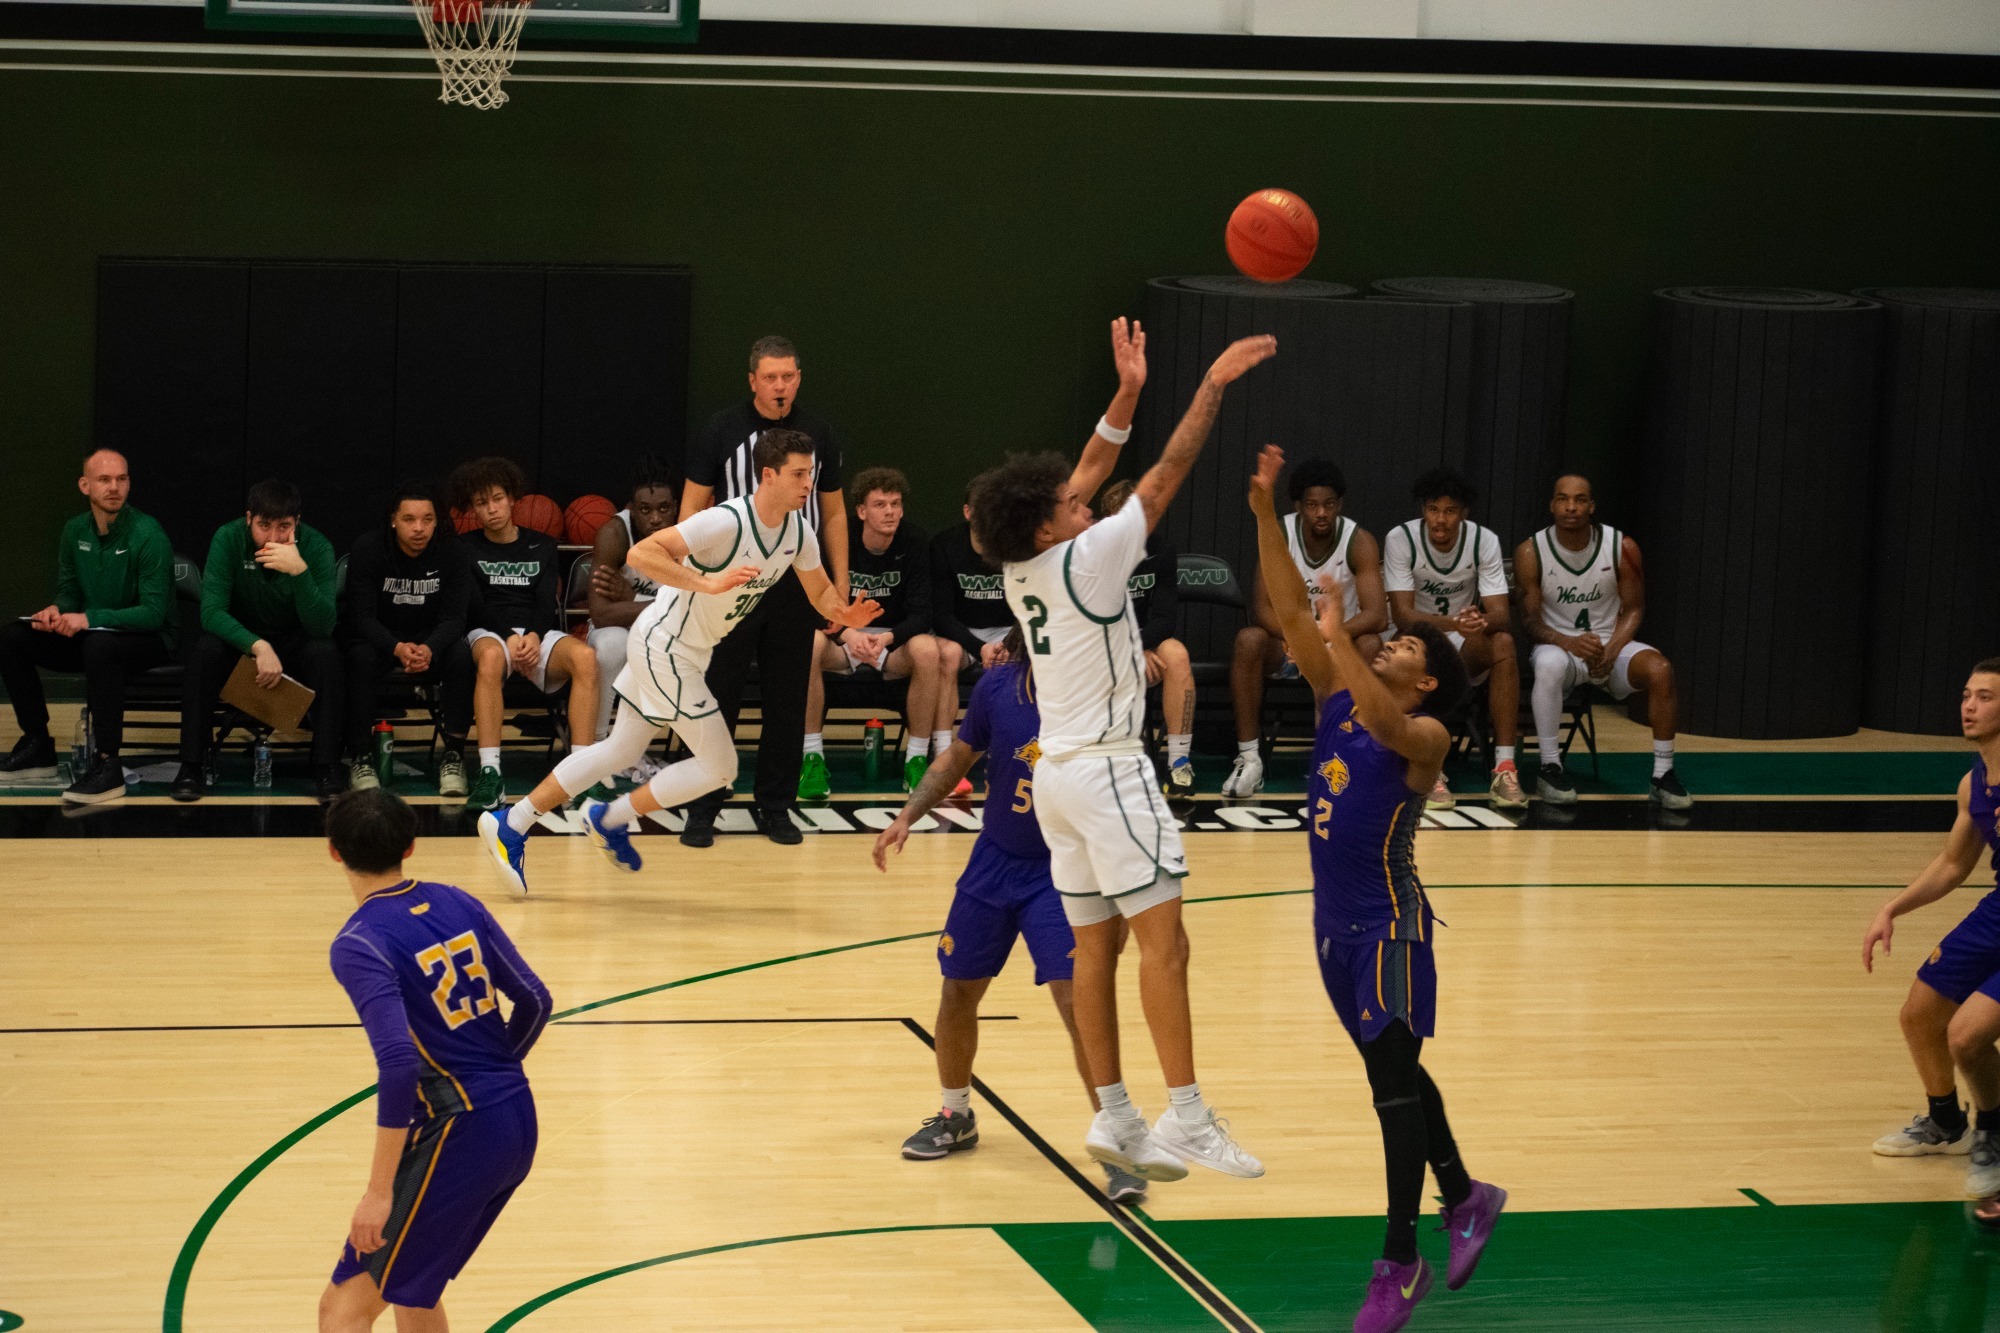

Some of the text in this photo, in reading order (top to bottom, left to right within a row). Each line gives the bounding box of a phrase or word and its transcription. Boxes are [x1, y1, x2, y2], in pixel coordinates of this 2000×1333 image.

[477, 560, 540, 577] WWU
[413, 578, 441, 595] WOODS
[489, 575, 531, 586] BASKETBALL
[633, 577, 658, 596] Woo
[849, 571, 901, 590] WWU
[1127, 573, 1155, 591] WU
[1420, 579, 1466, 596] Woods
[851, 587, 892, 600] BAKETBALL
[964, 589, 1004, 600] BASKETBALL
[1556, 583, 1604, 604] Woods
[725, 592, 765, 621] 30
[1434, 597, 1450, 616] 3
[1022, 595, 1052, 655] 2
[1575, 608, 1591, 632] 4
[1011, 778, 1033, 814] 5
[1314, 797, 1333, 840] 2
[415, 930, 497, 1030] 23
